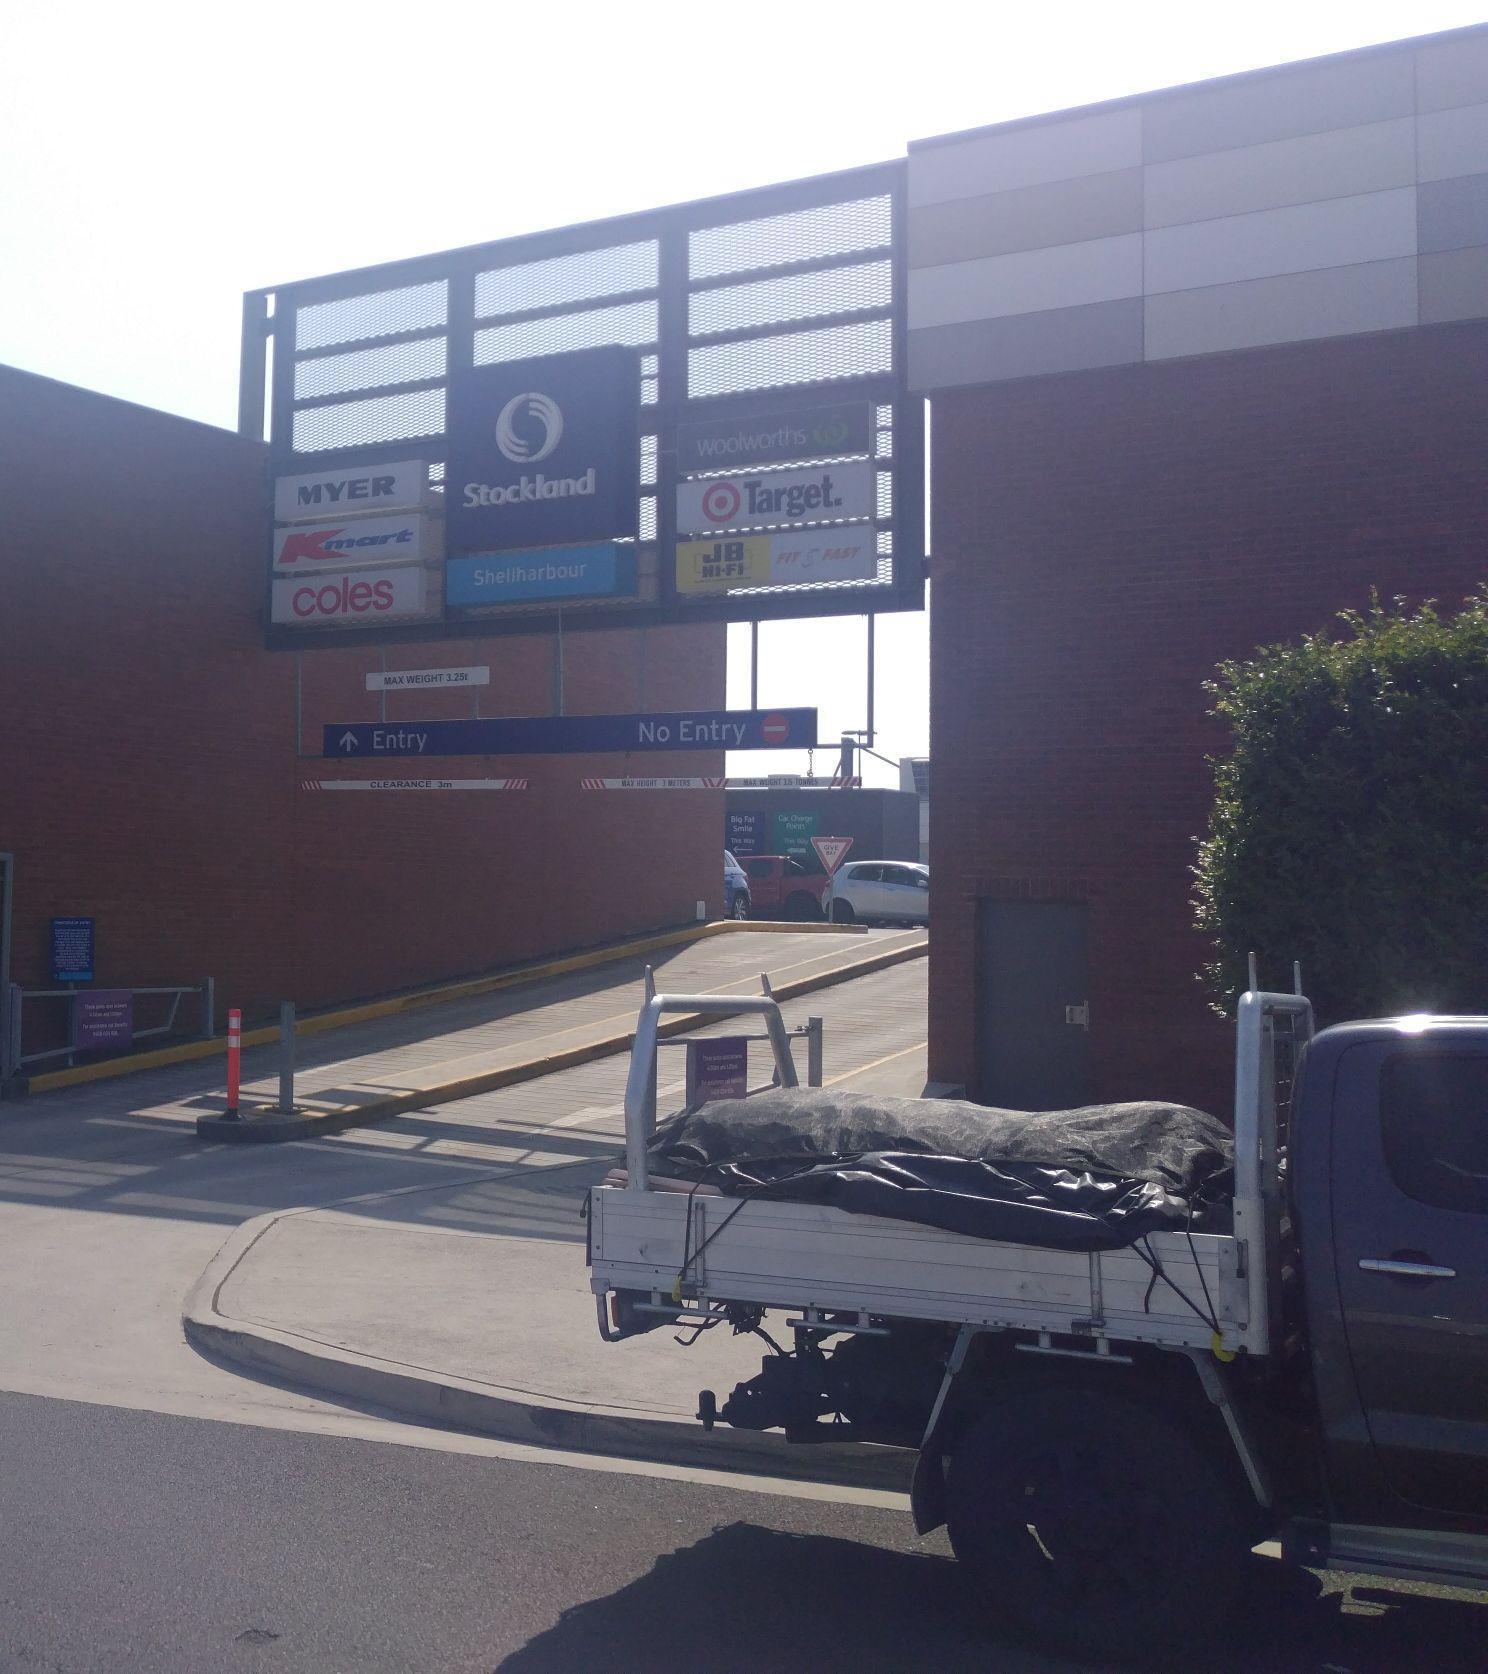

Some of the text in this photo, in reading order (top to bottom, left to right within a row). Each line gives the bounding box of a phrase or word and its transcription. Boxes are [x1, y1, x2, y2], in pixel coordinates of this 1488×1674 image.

[695, 424, 807, 457] woolworths
[297, 475, 396, 506] MYER
[461, 467, 597, 508] Stockland
[277, 528, 414, 564] Kmart
[701, 541, 745, 564] JB
[472, 561, 589, 587] Shellharbour
[291, 576, 395, 617] coles
[383, 674, 405, 686] MAX
[406, 672, 444, 685] WEIGHT
[372, 729, 428, 753] Entry
[638, 719, 747, 746] No Entry
[370, 780, 432, 789] CLEARANCE
[636, 779, 657, 787] HEIGHT
